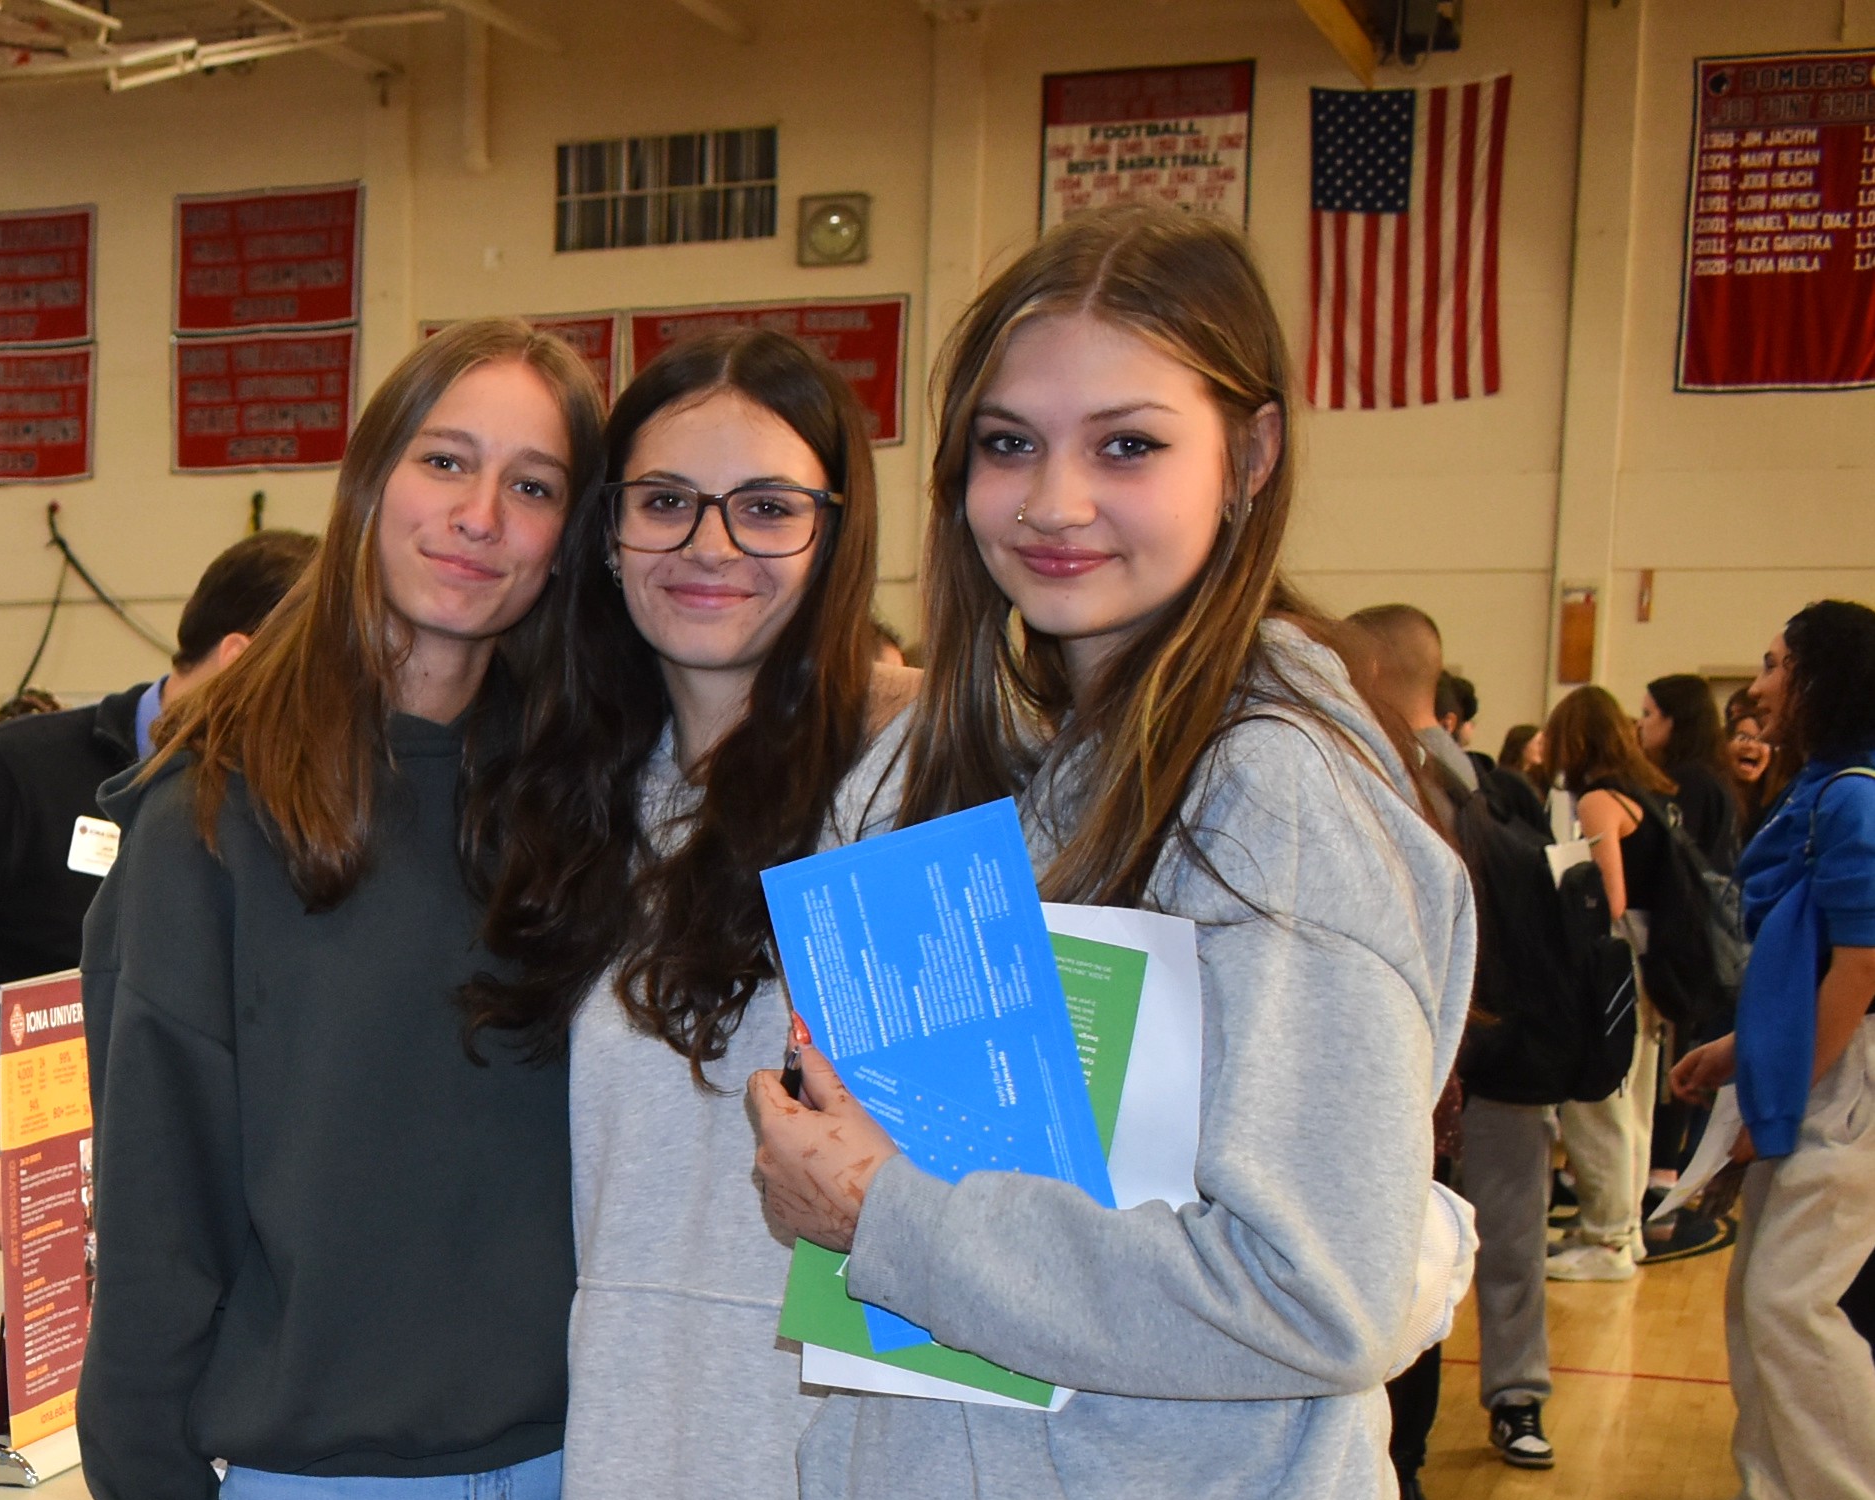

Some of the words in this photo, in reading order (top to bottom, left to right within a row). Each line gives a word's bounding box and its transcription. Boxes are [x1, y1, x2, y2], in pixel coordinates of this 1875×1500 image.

[1741, 62, 1868, 90] BOMBERS
[1089, 120, 1202, 140] FOOTBALL
[1116, 151, 1222, 172] BASKETBALL
[963, 886, 977, 918] WELLNESS
[803, 935, 814, 955] GOALS
[972, 923, 984, 948] HEALTH
[978, 948, 986, 956] IN
[808, 955, 820, 979] CAREER
[980, 956, 993, 984] CAREERS
[814, 978, 824, 995] YOUR
[818, 995, 826, 1004] TO
[912, 985, 926, 1018] PROGRAMS
[987, 984, 1002, 1018] POTENTIAL
[25, 1008, 49, 1033] IONA
[820, 1004, 834, 1033] TAILORED
[920, 1018, 931, 1036] GRAD
[827, 1033, 840, 1060] OPTIONS
[998, 1051, 1016, 1105] apply.jwu.edu
[995, 1085, 1006, 1107] Apply
